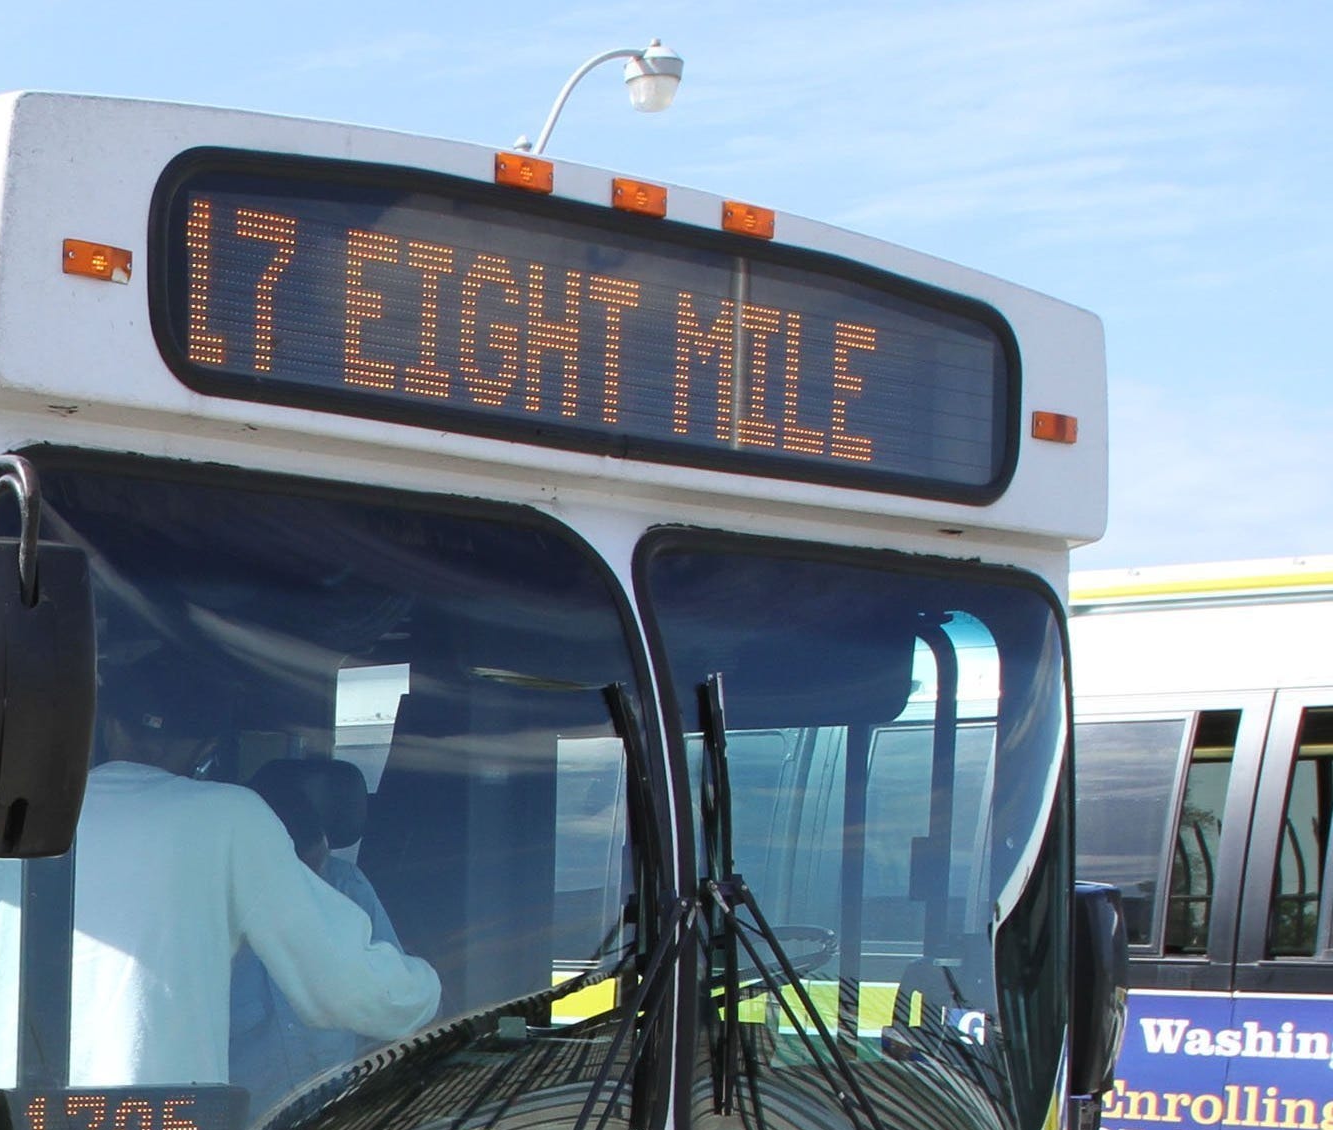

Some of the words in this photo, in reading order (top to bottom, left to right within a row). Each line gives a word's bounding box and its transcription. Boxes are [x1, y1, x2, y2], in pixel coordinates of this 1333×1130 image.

[187, 201, 296, 371] 17
[344, 230, 639, 424] EIGHT
[673, 291, 876, 462] MILE
[1139, 1018, 1333, 1069] Washin
